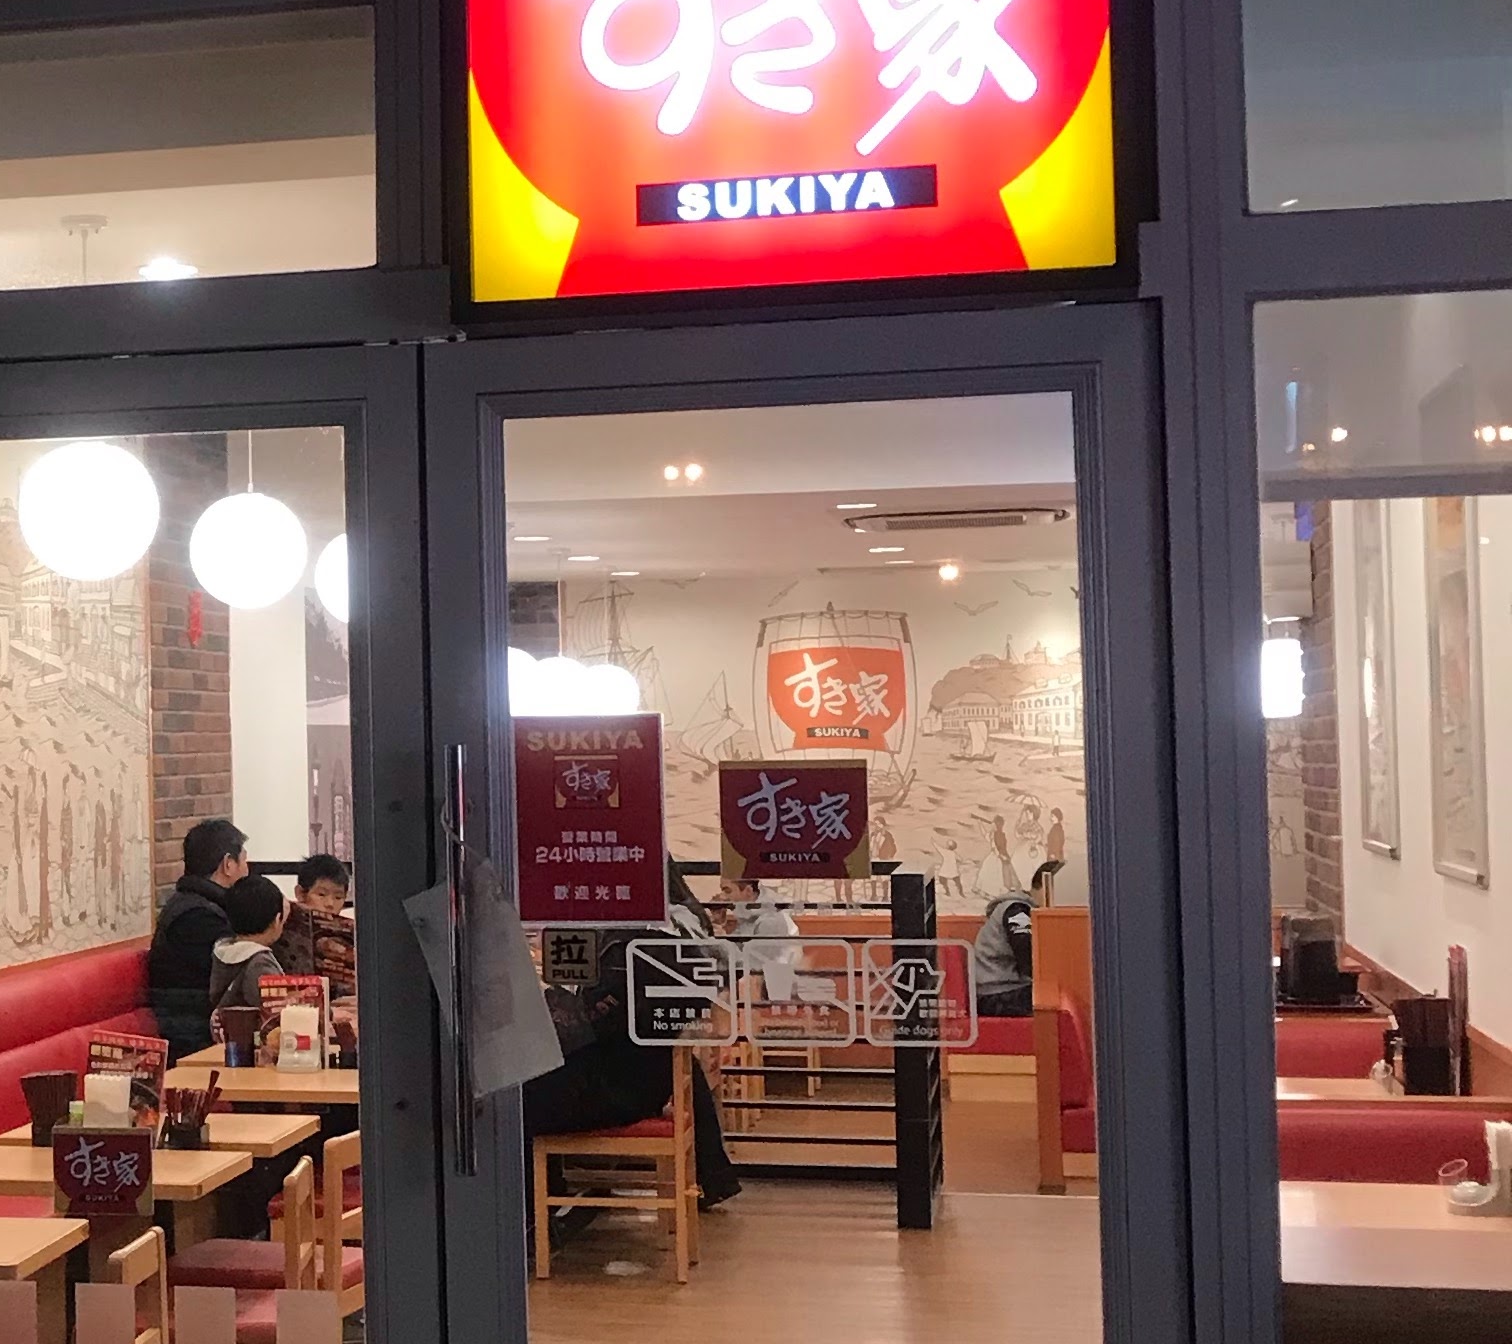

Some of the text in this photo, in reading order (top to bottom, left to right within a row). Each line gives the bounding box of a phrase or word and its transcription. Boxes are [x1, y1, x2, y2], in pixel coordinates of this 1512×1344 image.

[676, 169, 894, 222] SUKIYA
[785, 653, 891, 725] すき家
[527, 730, 644, 752] SUKIYA
[814, 727, 860, 738] SUKIYA
[562, 761, 611, 793] すき家
[738, 772, 852, 848] すき家
[769, 851, 820, 863] SUKIYA
[554, 884, 631, 901] 歡迎光臨
[550, 936, 589, 966] 拉
[552, 967, 588, 980] PULL
[653, 1020, 668, 1031] No
[64, 1136, 141, 1193] すき家
